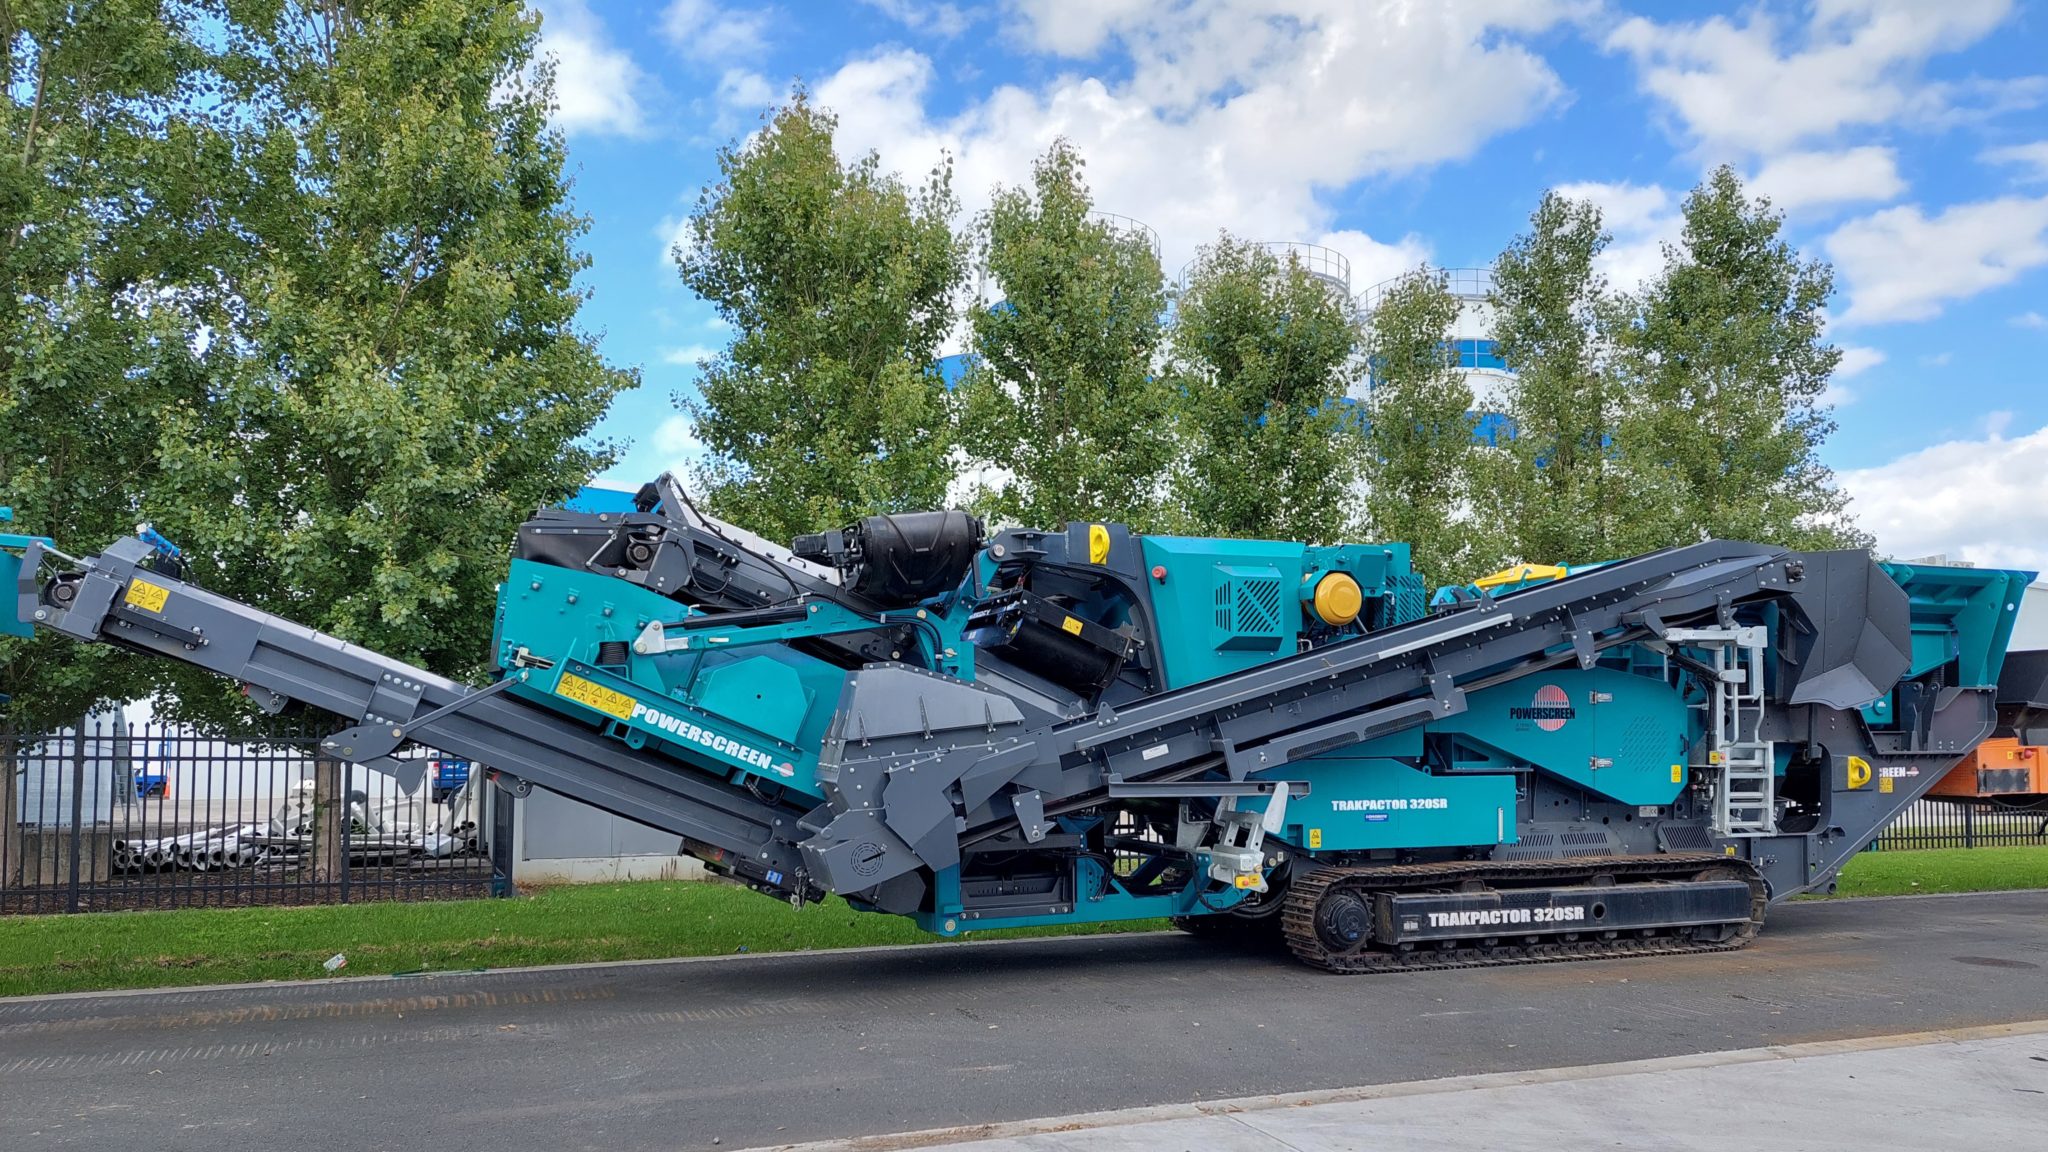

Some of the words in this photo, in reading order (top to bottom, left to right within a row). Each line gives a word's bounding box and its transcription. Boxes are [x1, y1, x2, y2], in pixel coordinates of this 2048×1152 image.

[1510, 707, 1576, 720] POWERSCREEN
[631, 703, 773, 770] POWERSCREEN
[1331, 799, 1408, 811] TRAKPACTOR
[1409, 798, 1448, 810] 320SR
[1428, 909, 1531, 927] TRAKPACTOR
[1533, 906, 1585, 923] 320SR
